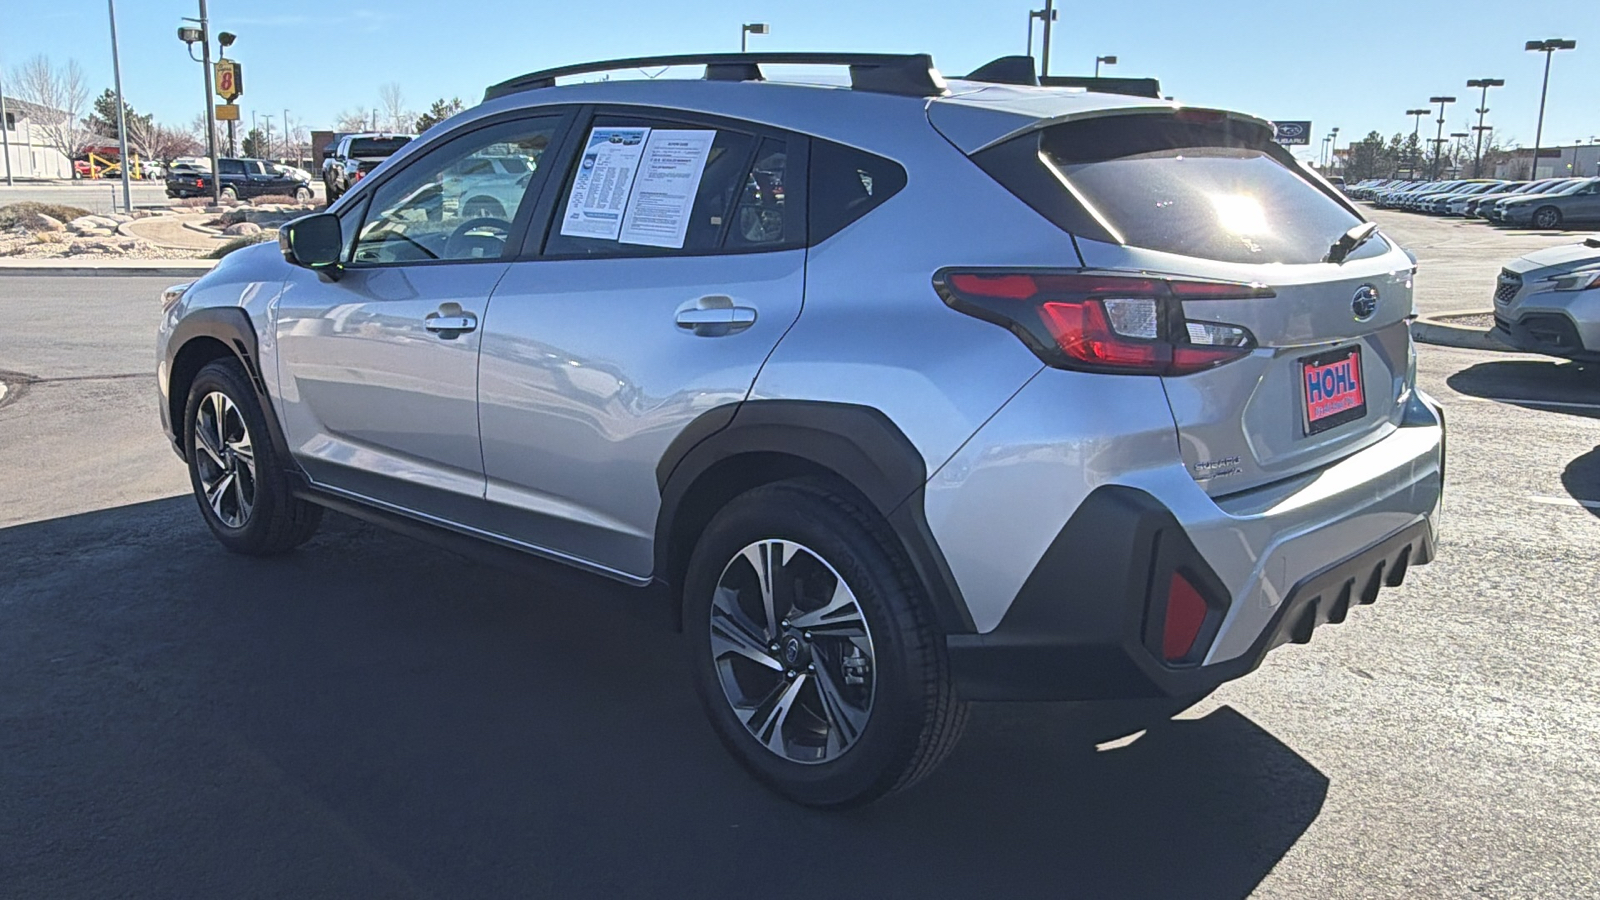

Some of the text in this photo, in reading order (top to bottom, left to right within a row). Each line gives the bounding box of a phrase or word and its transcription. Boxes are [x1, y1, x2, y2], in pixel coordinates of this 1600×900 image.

[220, 72, 232, 91] 8
[1308, 362, 1356, 404] HOHL
[1194, 456, 1241, 471] SUBARU
